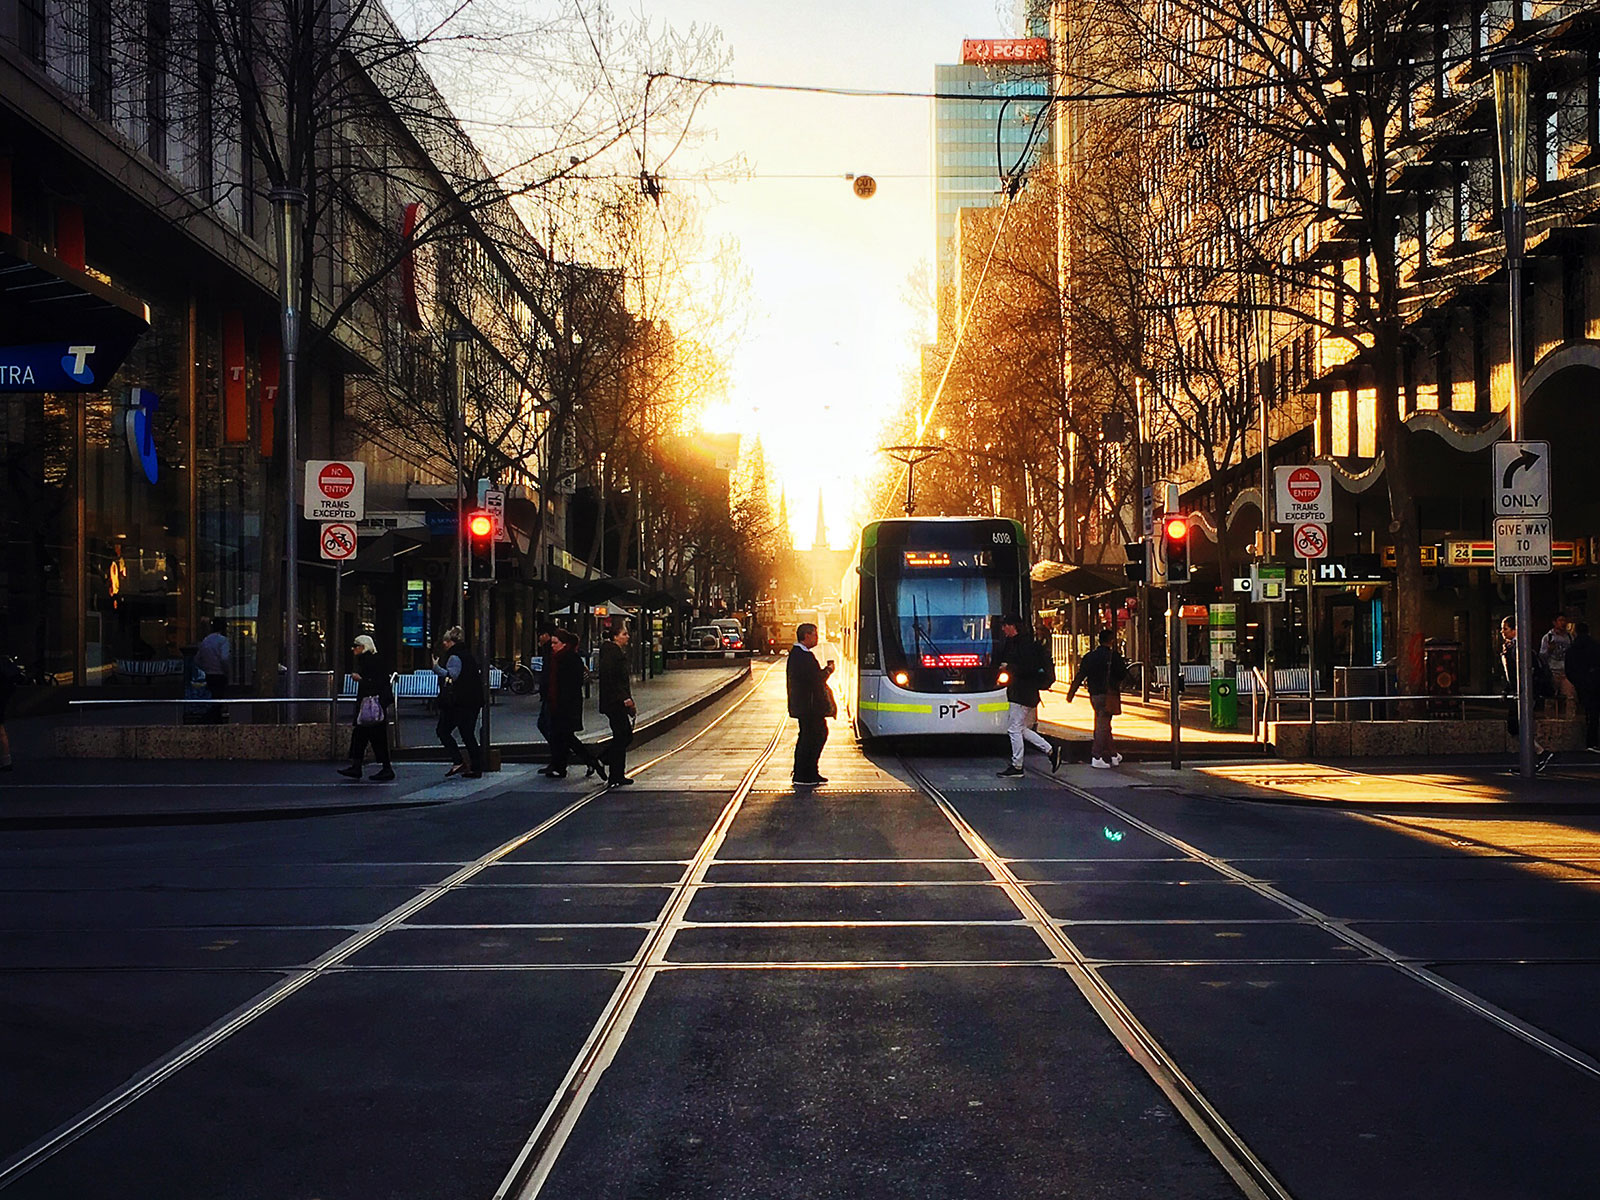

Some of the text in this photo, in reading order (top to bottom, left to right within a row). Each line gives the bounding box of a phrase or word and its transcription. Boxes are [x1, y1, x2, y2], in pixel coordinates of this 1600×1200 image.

[1192, 135, 1205, 147] 41
[856, 178, 873, 187] CUT
[857, 187, 873, 196] OFF
[331, 468, 343, 476] NO
[1299, 472, 1310, 480] NO
[324, 485, 350, 493] ENTRY
[1293, 489, 1318, 497] ENTRY
[320, 500, 350, 509] TRAMS
[1501, 494, 1542, 508] ONLY
[1291, 503, 1319, 511] TRAMS
[313, 509, 356, 518] EXCEPTED
[1285, 512, 1326, 520] EXCEPTED
[1498, 524, 1547, 535] GIVE WAY
[992, 533, 1012, 544] 6018
[1517, 540, 1530, 551] TO
[1455, 549, 1469, 558] 24
[1499, 555, 1548, 567] PEDESTRIANS
